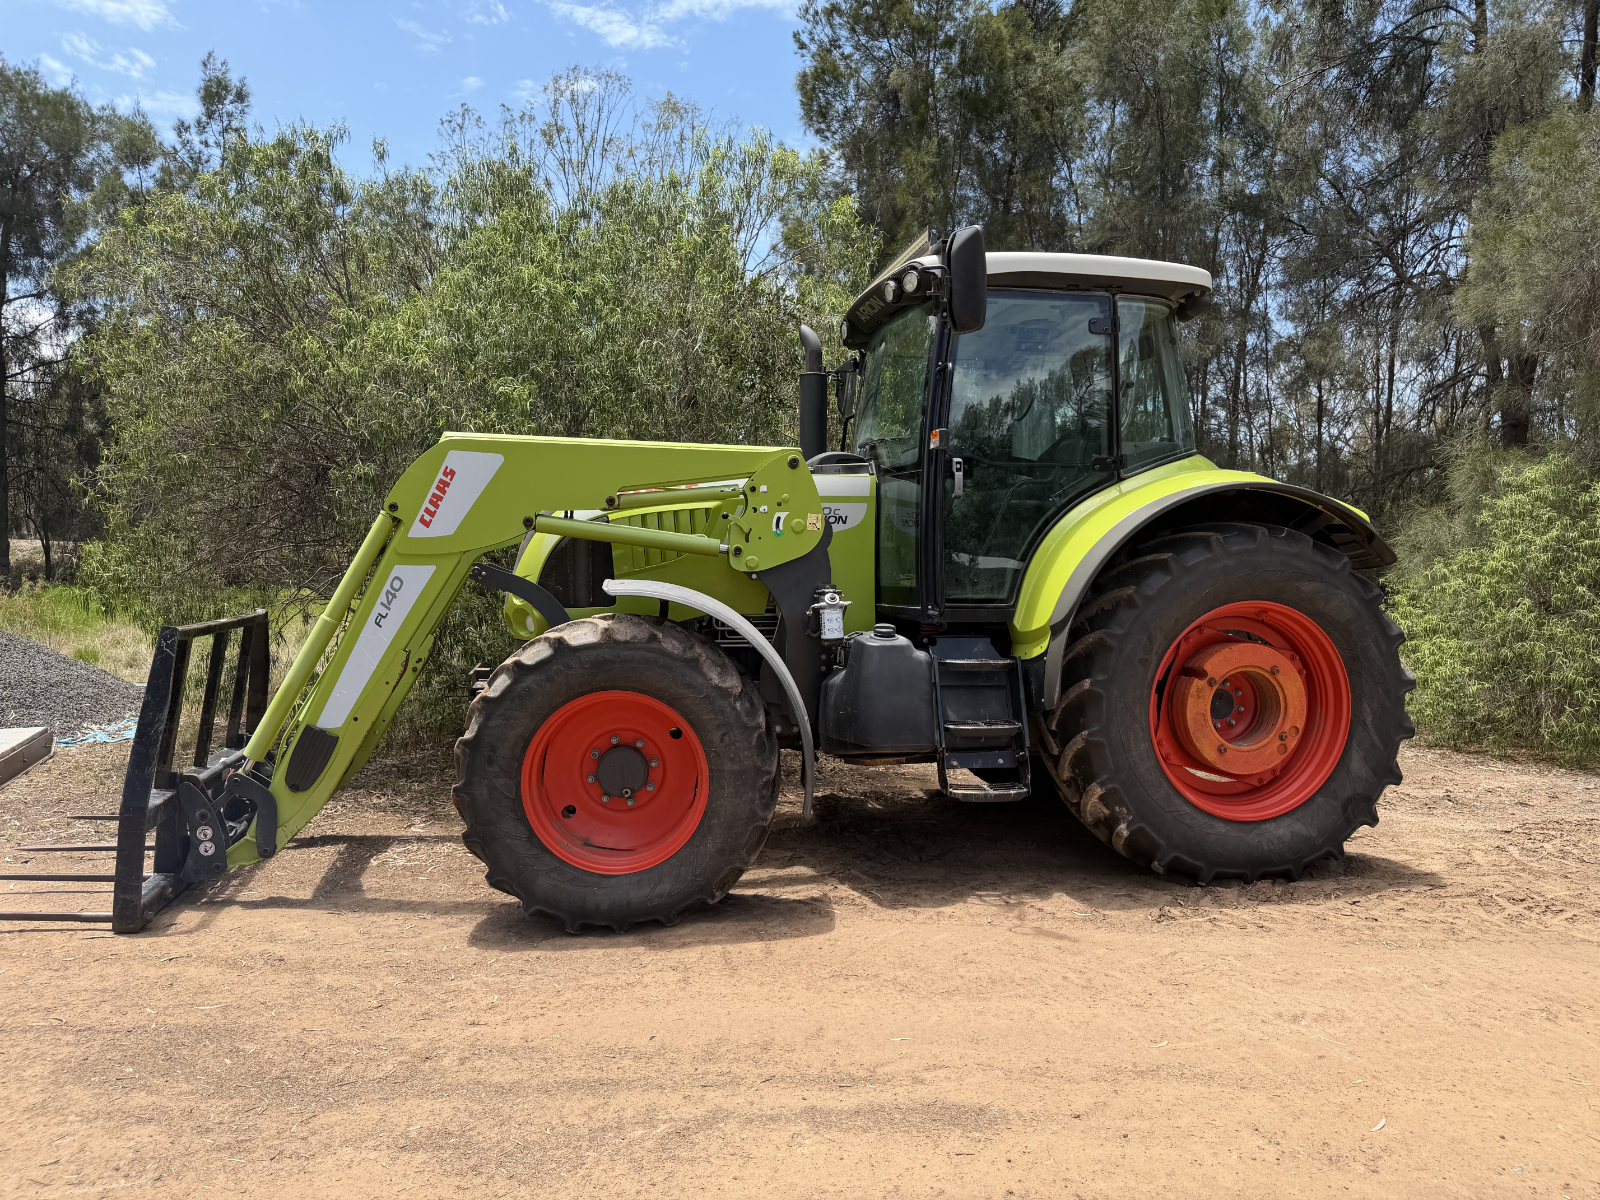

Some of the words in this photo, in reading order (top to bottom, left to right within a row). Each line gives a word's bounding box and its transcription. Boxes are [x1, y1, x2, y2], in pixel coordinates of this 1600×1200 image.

[856, 295, 885, 322] ARION
[418, 465, 457, 529] CLAAS
[374, 575, 404, 629] FL140
